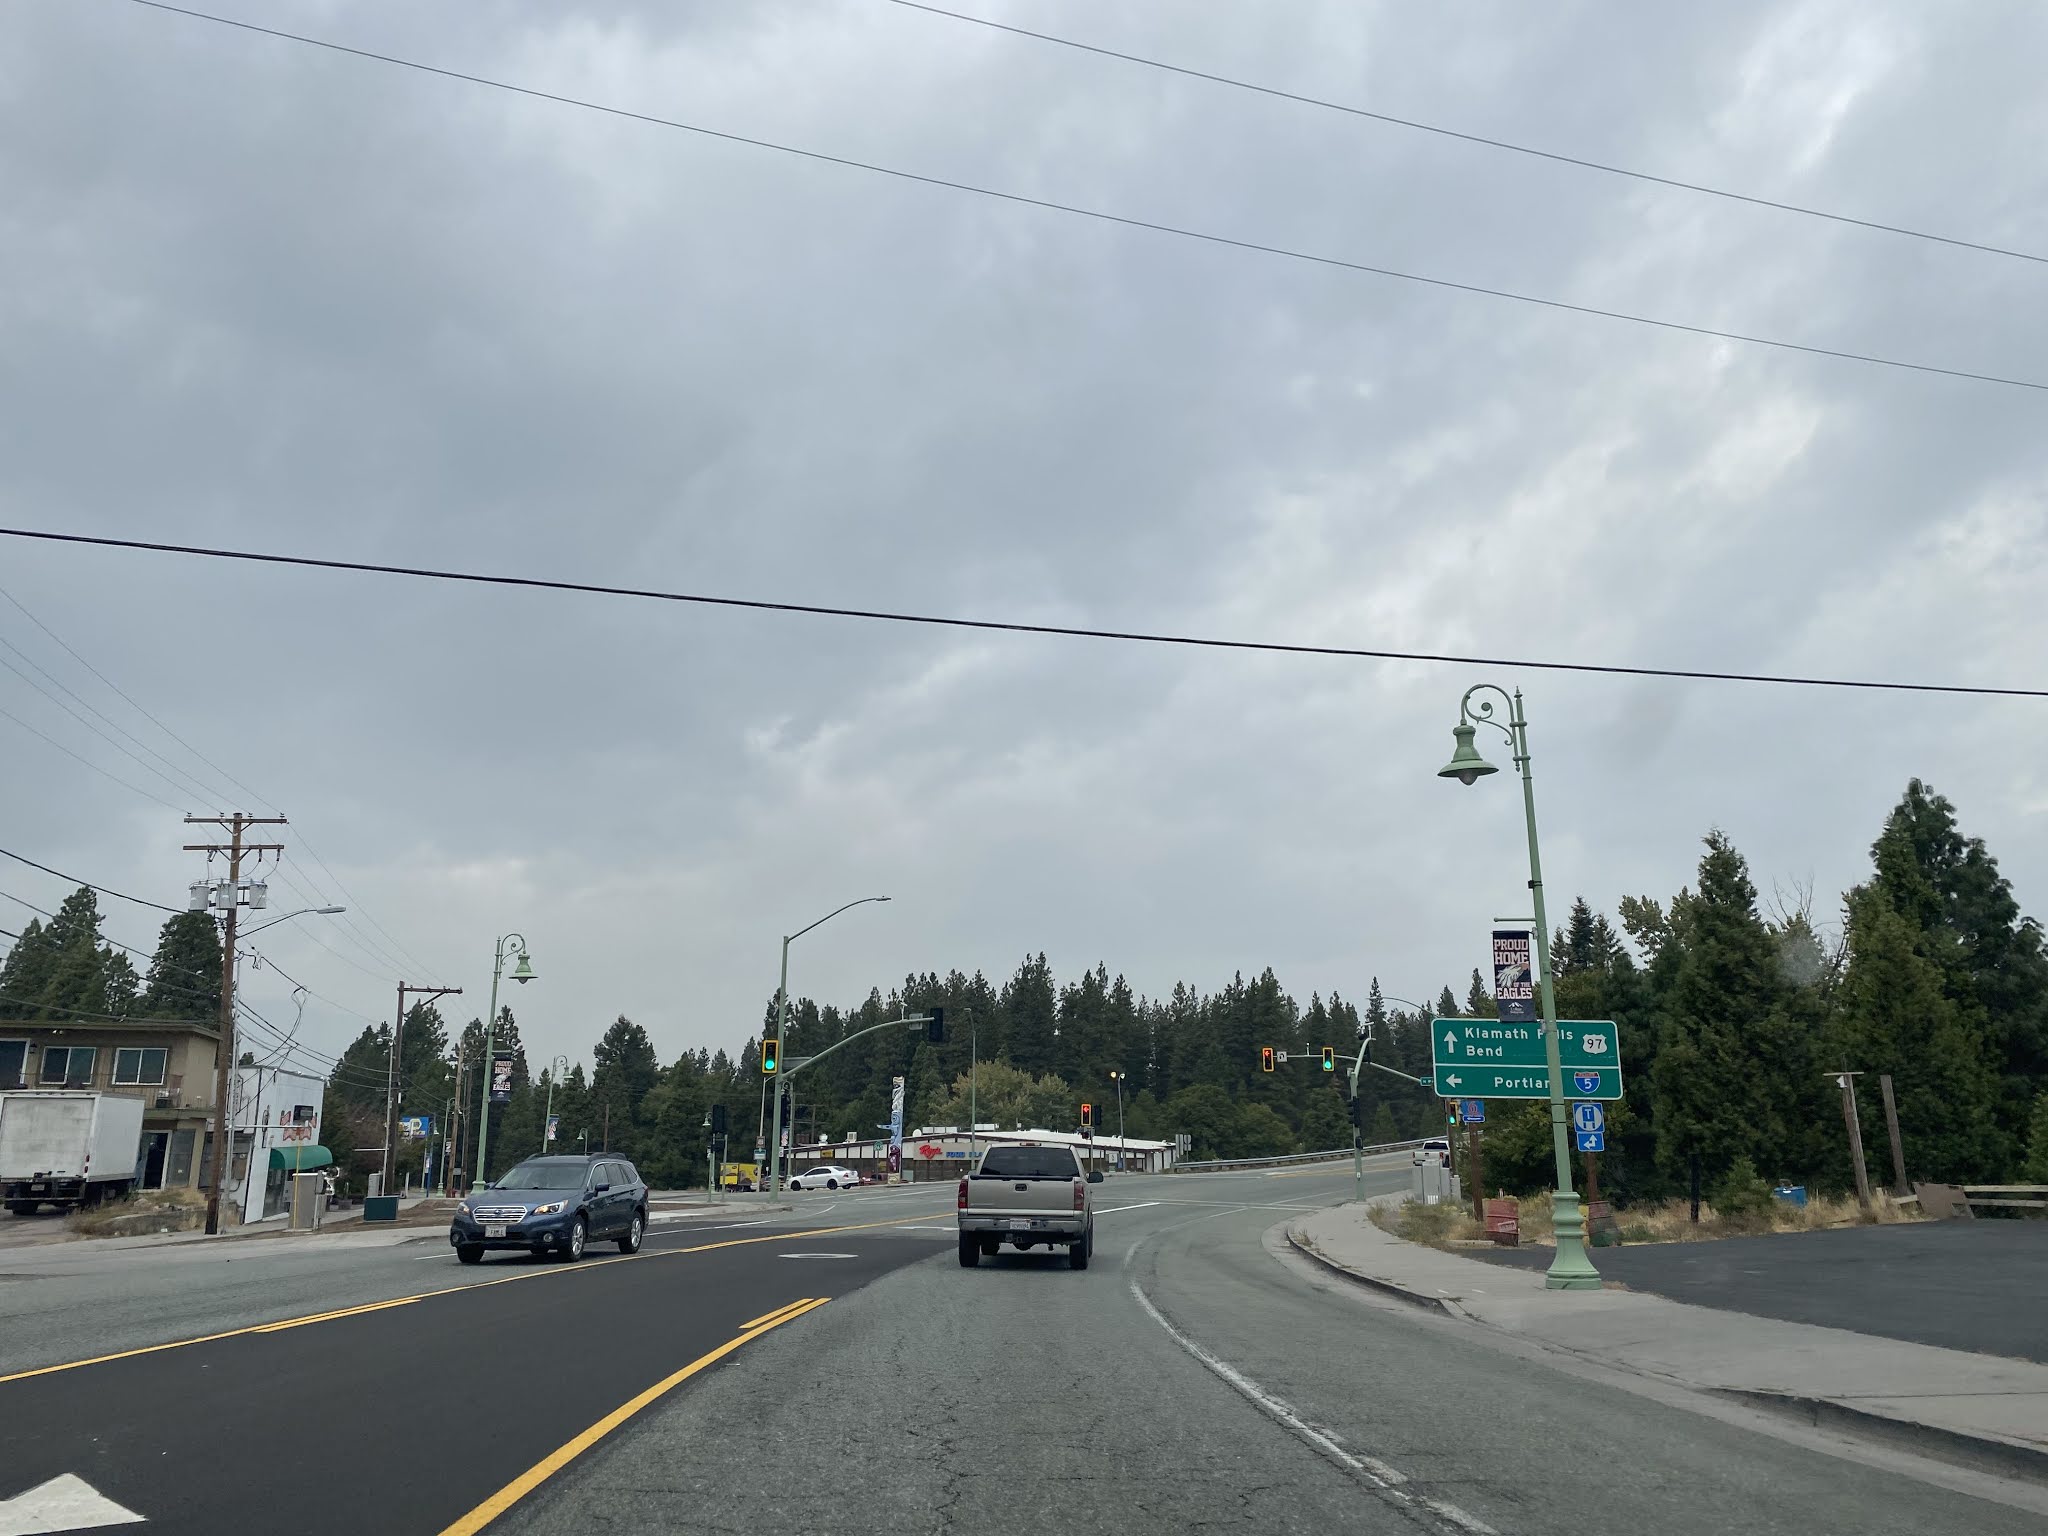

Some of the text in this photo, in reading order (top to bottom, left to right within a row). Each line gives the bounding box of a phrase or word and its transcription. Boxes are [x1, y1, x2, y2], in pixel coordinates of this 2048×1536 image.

[1494, 939, 1529, 951] PROUD
[1494, 951, 1529, 965] HOME
[1497, 987, 1533, 1000] EAGLES
[1465, 1027, 1574, 1040] Klamath Flls
[1586, 1038, 1603, 1050] 97
[1466, 1045, 1503, 1057] Bend
[1584, 1078, 1593, 1090] 5
